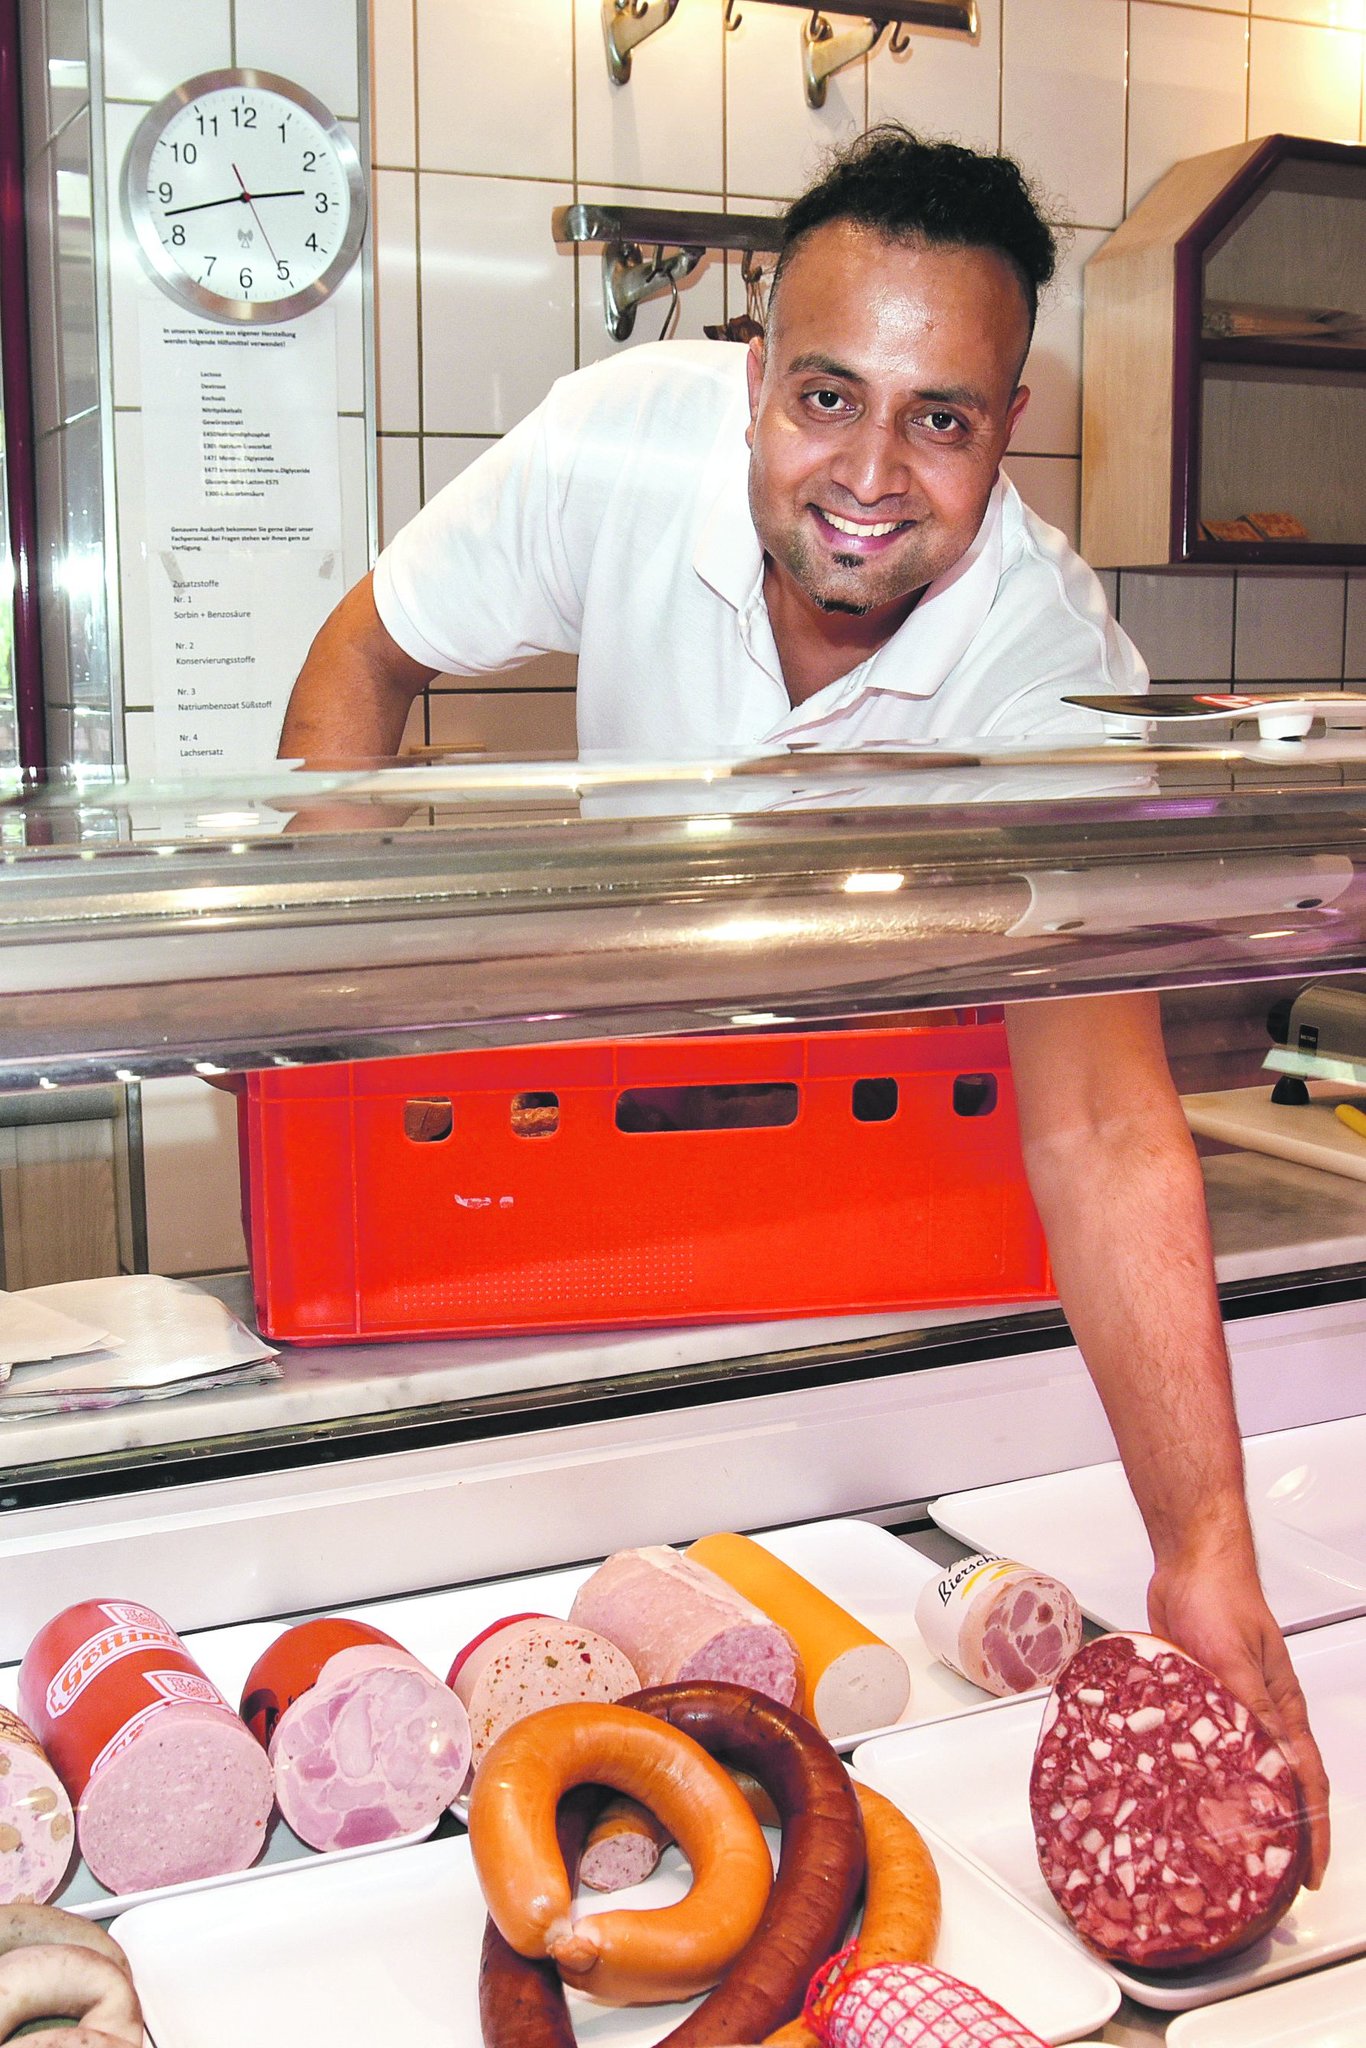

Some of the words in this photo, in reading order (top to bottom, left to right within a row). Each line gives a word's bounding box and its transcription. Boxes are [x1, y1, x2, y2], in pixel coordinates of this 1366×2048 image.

[197, 116, 218, 136] 11
[231, 107, 257, 128] 12
[278, 124, 286, 143] 1
[171, 143, 197, 164] 10
[303, 152, 316, 172] 2
[159, 183, 173, 203] 9
[315, 193, 328, 213] 3
[172, 225, 185, 246] 8
[305, 233, 318, 252] 4
[204, 256, 217, 276] 7
[277, 260, 290, 280] 5
[240, 268, 252, 288] 6
[262, 330, 296, 338] Herstellung
[173, 580, 219, 588] Zusatzstoffe
[174, 610, 199, 618] Sorbin
[208, 610, 251, 618] Benzosäure
[176, 642, 187, 650] Nr.
[176, 656, 255, 665] Konservierungsstoffe
[178, 702, 239, 711] Natriumbenzoat
[241, 700, 272, 709] Süßstoff
[180, 748, 223, 757] Lachsersatz
